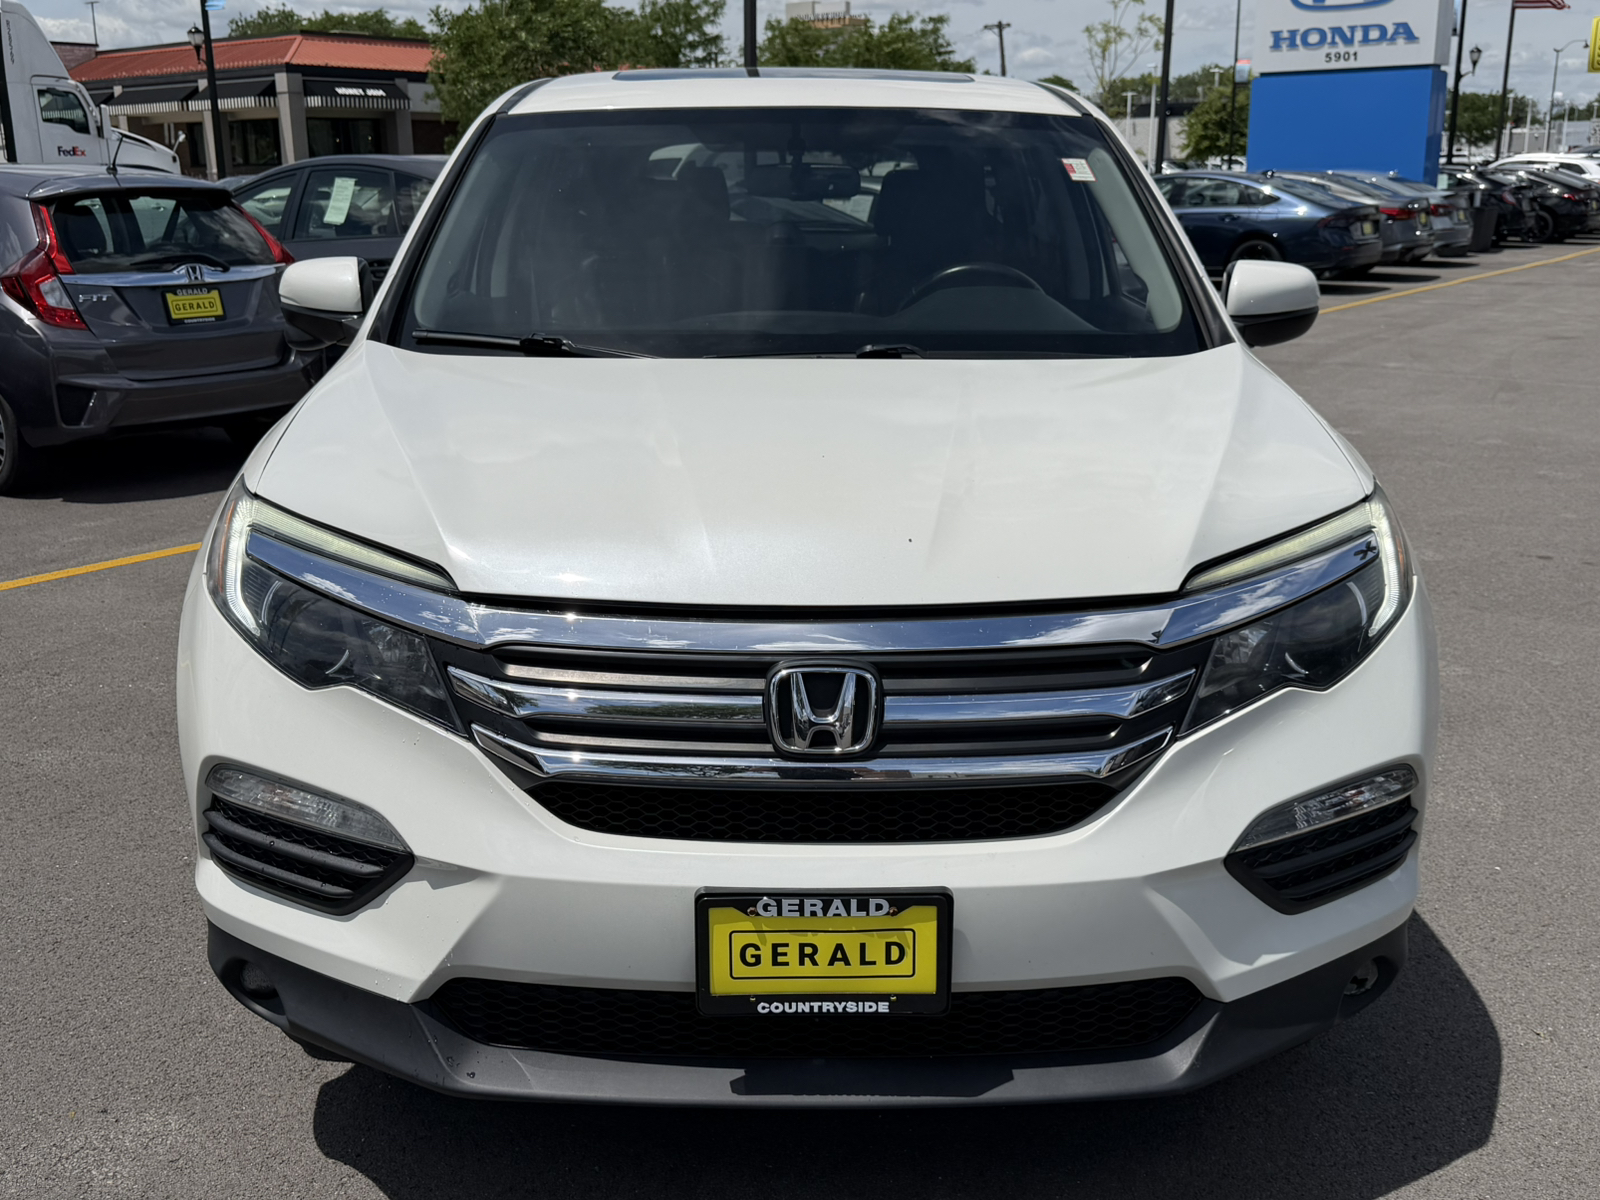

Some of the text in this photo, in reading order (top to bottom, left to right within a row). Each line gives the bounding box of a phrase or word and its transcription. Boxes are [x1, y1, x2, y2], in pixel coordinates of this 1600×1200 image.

[1269, 21, 1420, 50] HONDA
[1324, 51, 1358, 63] 5901
[57, 145, 87, 157] FedEx
[176, 288, 208, 296] GERALD
[174, 300, 215, 312] GERALD
[756, 898, 890, 918] GERALD
[739, 941, 906, 968] GERALD
[757, 1001, 890, 1014] COUNTRYSIDE
